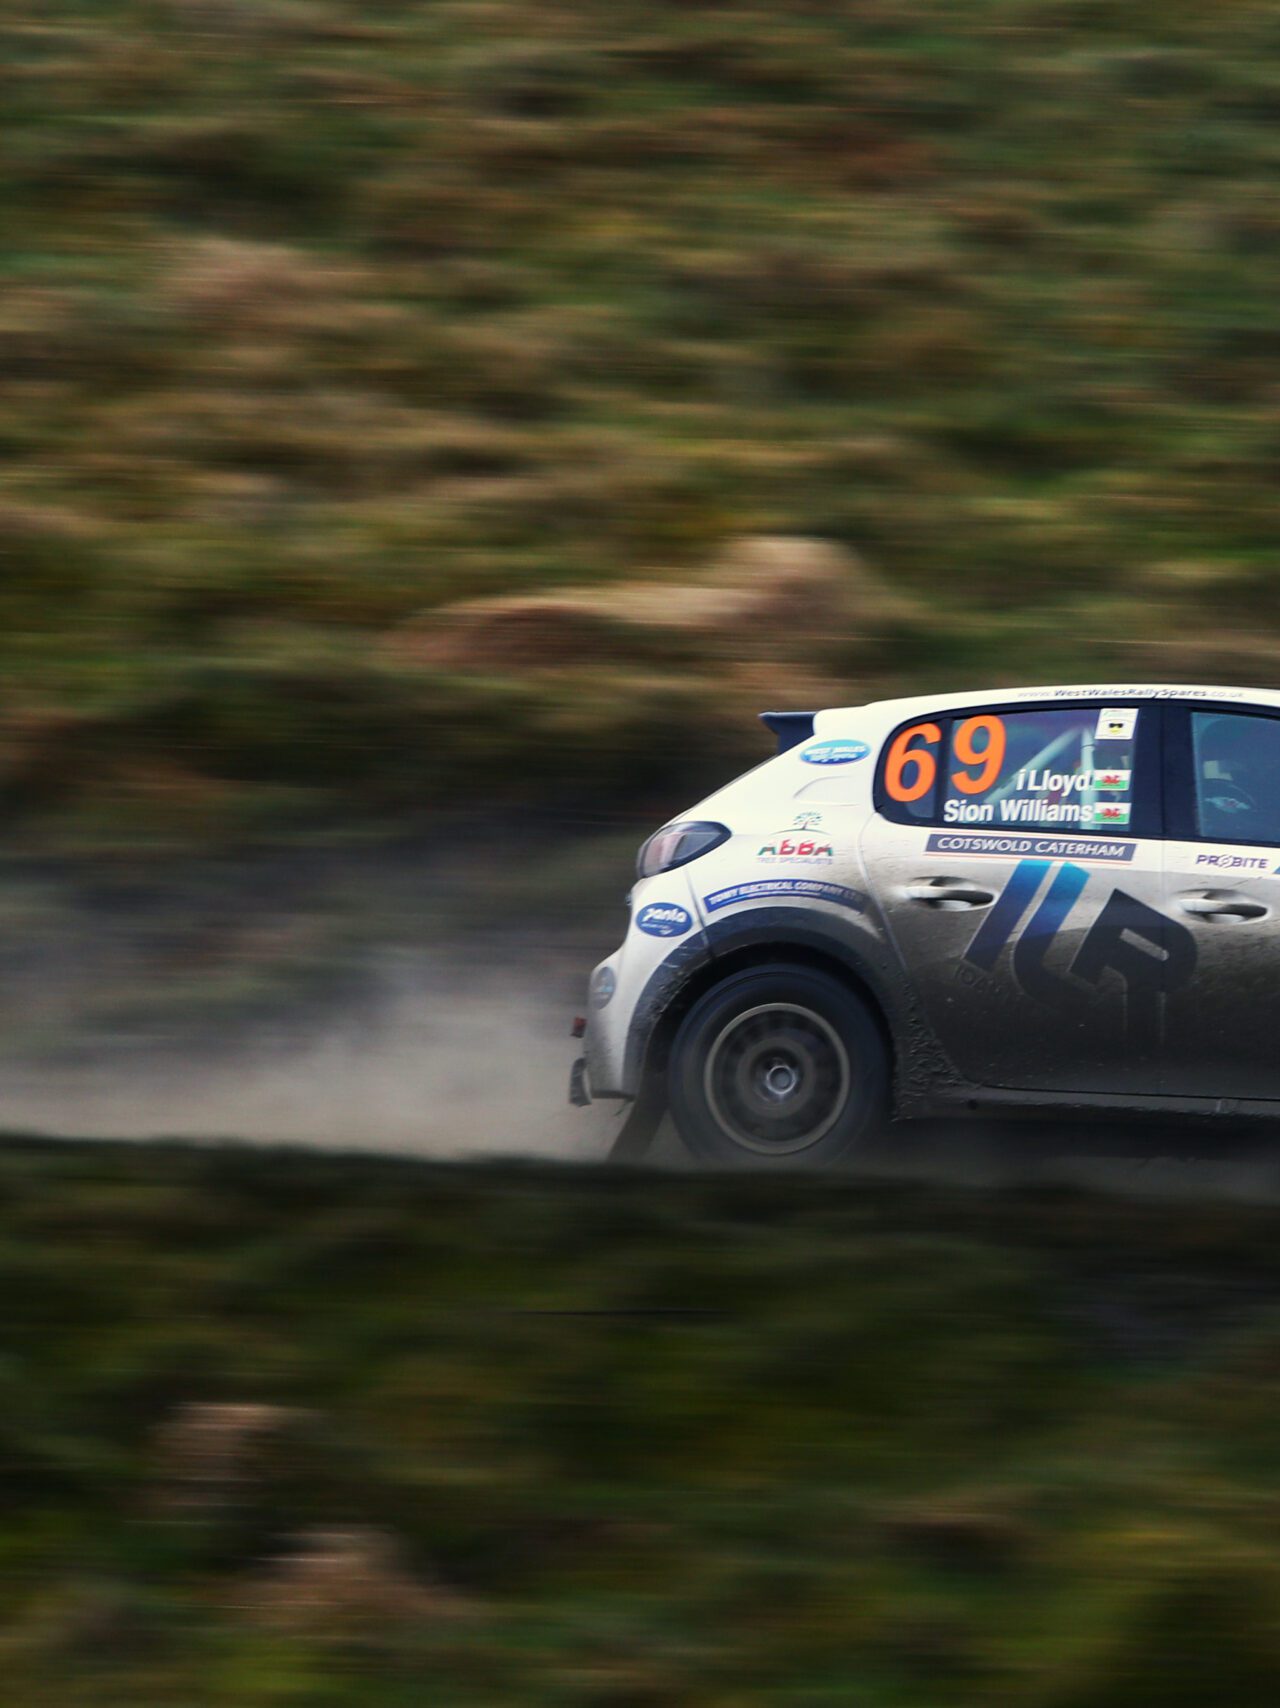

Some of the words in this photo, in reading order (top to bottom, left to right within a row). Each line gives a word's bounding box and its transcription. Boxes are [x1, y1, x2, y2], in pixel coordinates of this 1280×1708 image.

[884, 714, 1006, 802] 69
[1027, 769, 1091, 798] Lloyd
[943, 799, 994, 822] Sion
[1000, 799, 1094, 823] Williams
[937, 836, 1031, 853] COTSWOLD
[1034, 840, 1126, 858] CATERHAM
